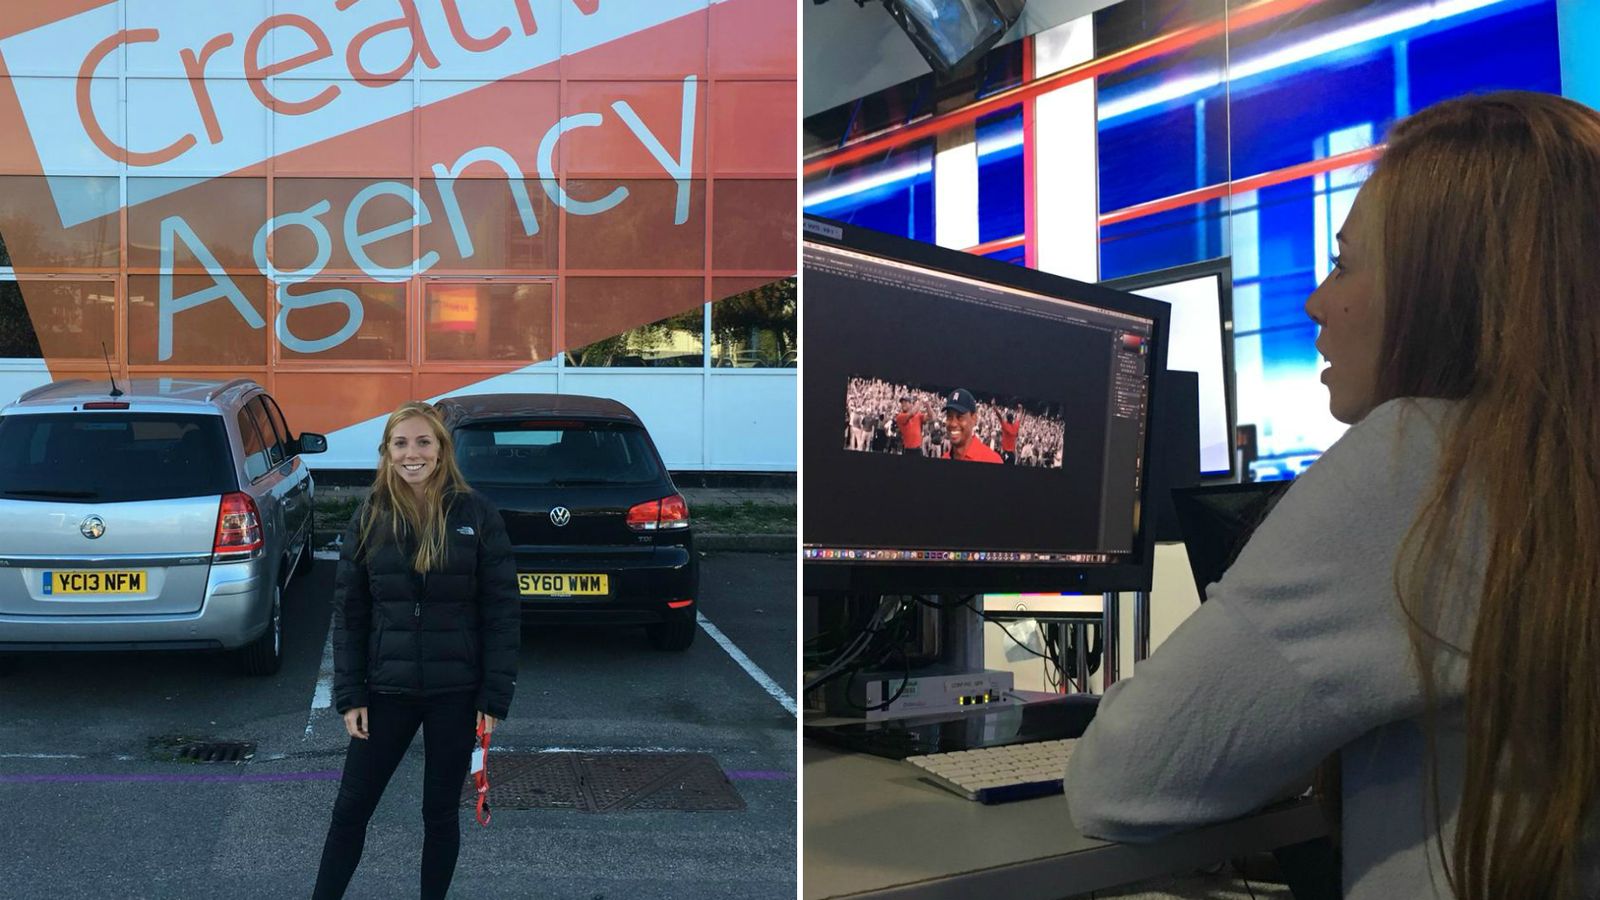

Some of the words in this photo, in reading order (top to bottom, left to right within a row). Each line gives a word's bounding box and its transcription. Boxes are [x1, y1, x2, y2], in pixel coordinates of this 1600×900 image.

[76, 0, 600, 167] Crea
[158, 75, 698, 361] Agency
[59, 574, 100, 590] YC13
[105, 574, 140, 590] NFM
[520, 576, 563, 590] SY60
[568, 576, 600, 591] WWM
